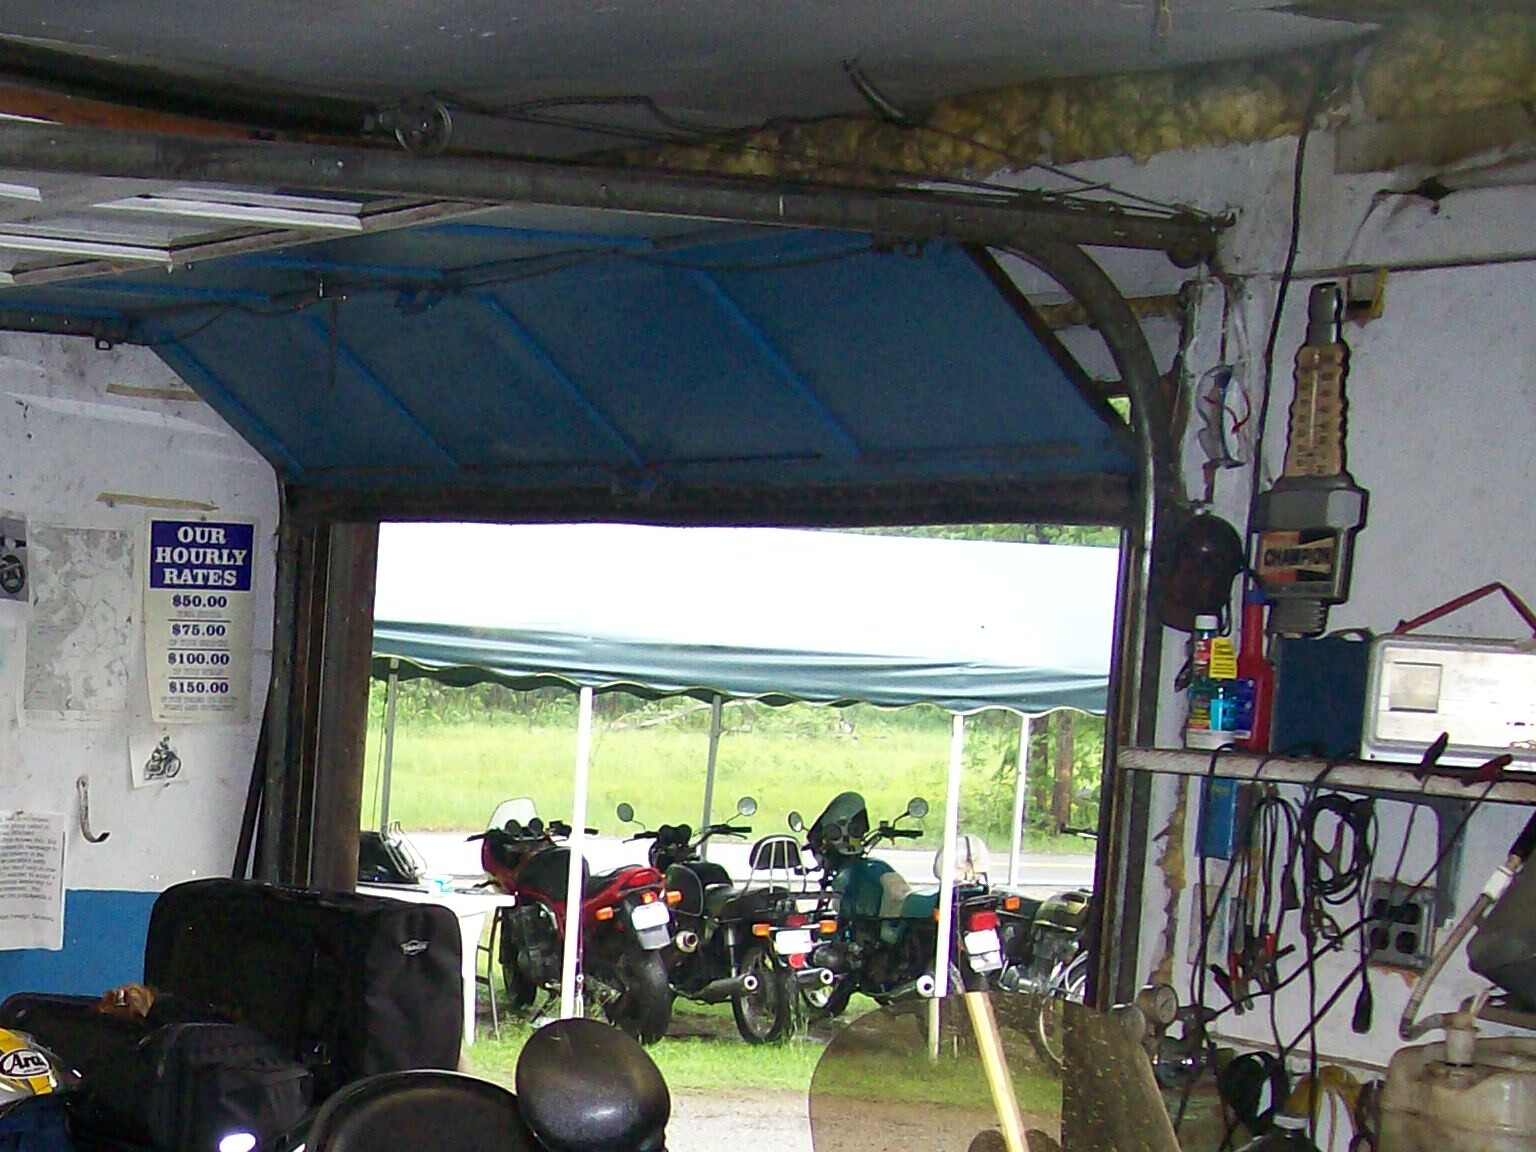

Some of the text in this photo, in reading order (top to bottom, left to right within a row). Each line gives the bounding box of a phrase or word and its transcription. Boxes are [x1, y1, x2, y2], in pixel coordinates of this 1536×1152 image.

[177, 526, 227, 545] OUR
[155, 546, 248, 567] HOURLY
[163, 568, 238, 587] RATES
[172, 594, 228, 608] $50.00
[172, 623, 226, 637] $75.00
[168, 652, 230, 665] $100.00
[169, 681, 229, 694] $150.00
